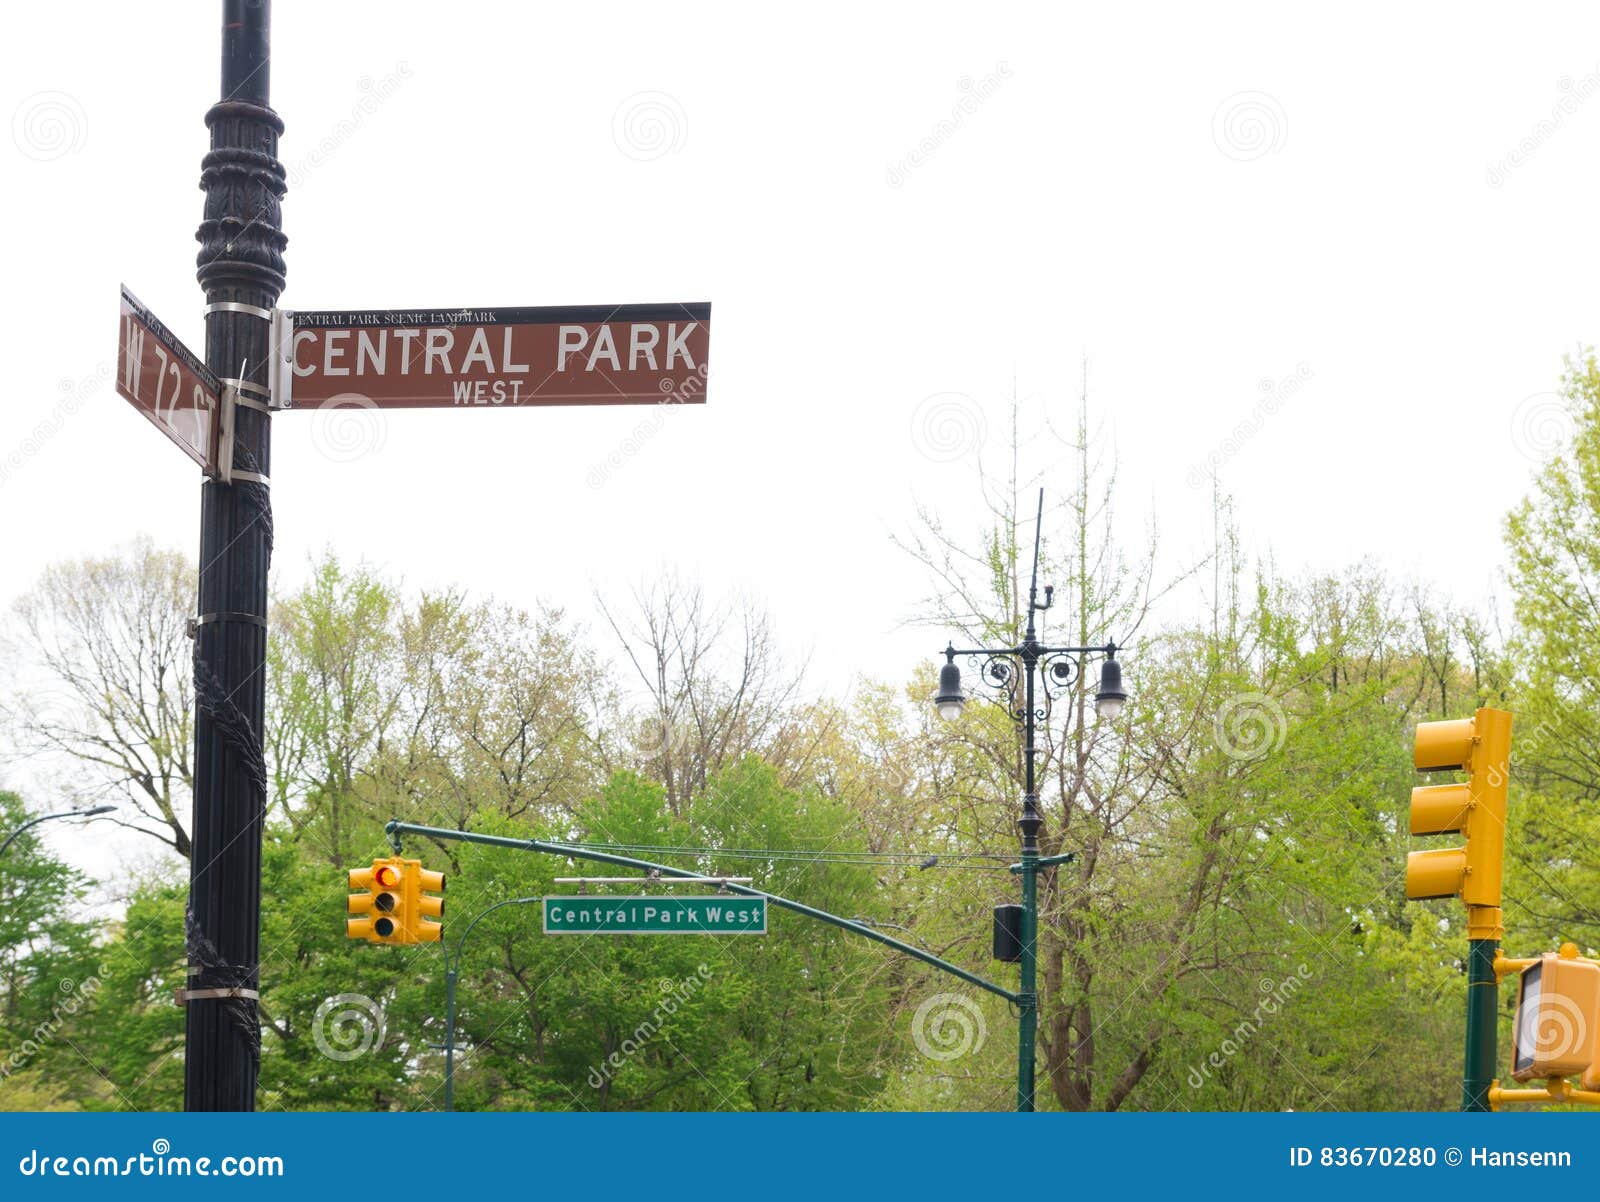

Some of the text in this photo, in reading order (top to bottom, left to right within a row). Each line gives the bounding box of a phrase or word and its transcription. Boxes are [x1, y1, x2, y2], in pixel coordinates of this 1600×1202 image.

[294, 311, 497, 325] ENTRAL PARK SCENIC LANDMARK
[292, 322, 698, 377] CENTRAL PARK
[124, 316, 217, 467] W 72 ST
[453, 380, 524, 405] WEST
[550, 906, 760, 923] Central Park West
